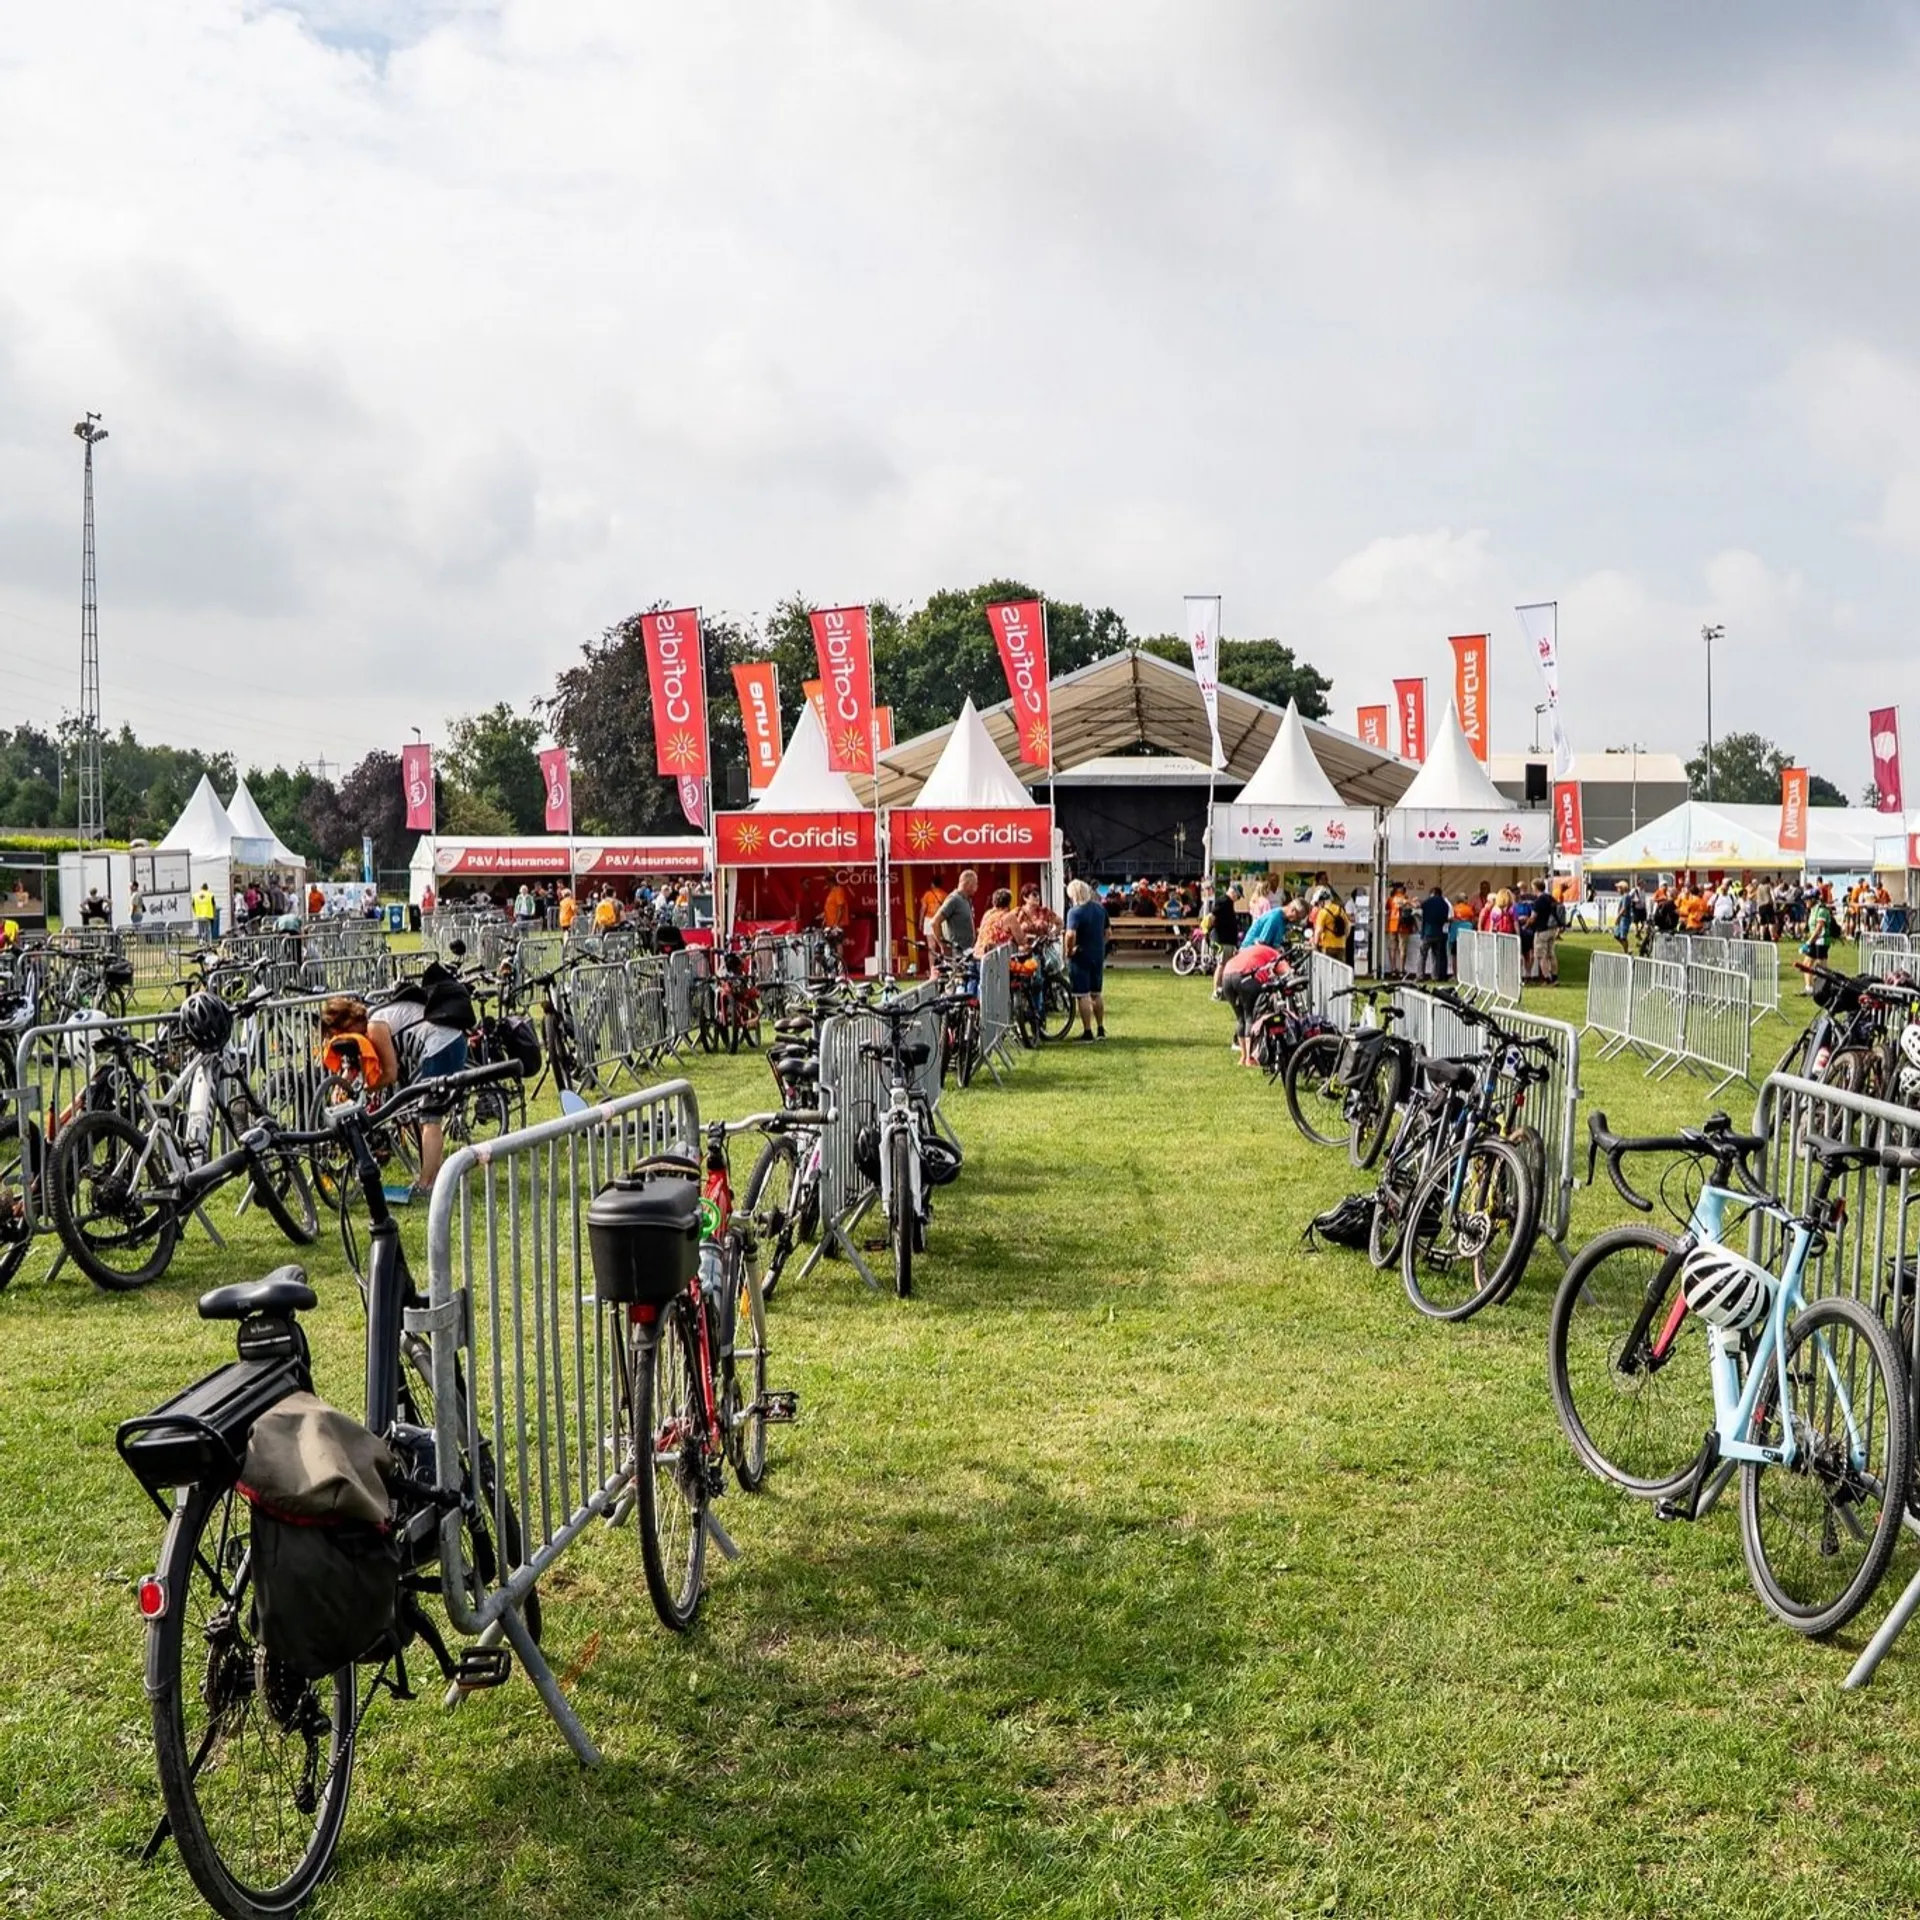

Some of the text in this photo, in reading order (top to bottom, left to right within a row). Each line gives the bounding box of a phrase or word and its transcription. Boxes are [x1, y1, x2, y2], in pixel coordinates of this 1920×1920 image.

[768, 827, 857, 848] Cofidis
[943, 823, 1034, 845] Cofidis
[467, 855, 492, 867] P&V
[496, 855, 565, 867] Assurances
[605, 855, 631, 866] P&V
[634, 855, 699, 866] Assurances
